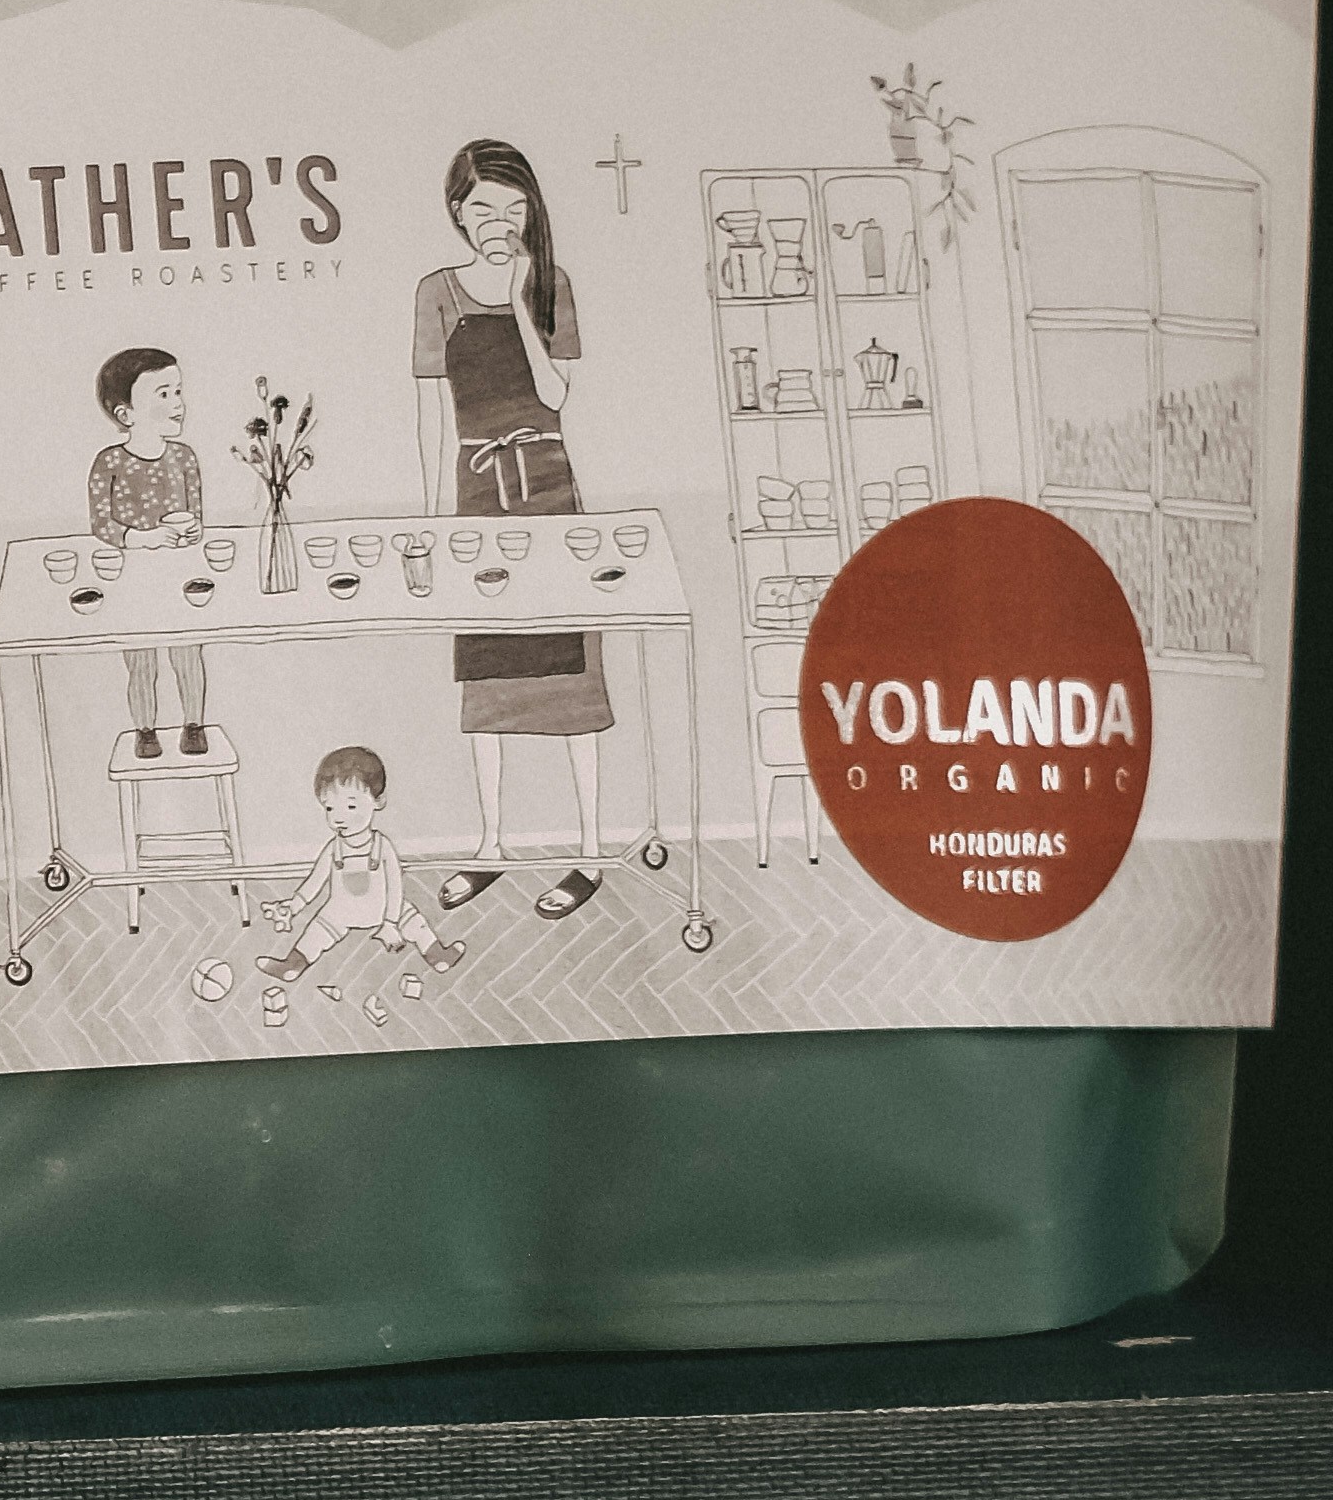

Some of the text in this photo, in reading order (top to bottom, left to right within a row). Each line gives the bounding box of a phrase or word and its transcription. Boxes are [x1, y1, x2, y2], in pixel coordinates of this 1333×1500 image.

[131, 258, 343, 288] ROASTERY
[819, 676, 1135, 748] YOLANDA
[846, 762, 1131, 794] ORGANIC
[929, 829, 1067, 860] HONDURAS
[961, 868, 1043, 895] FILTER
